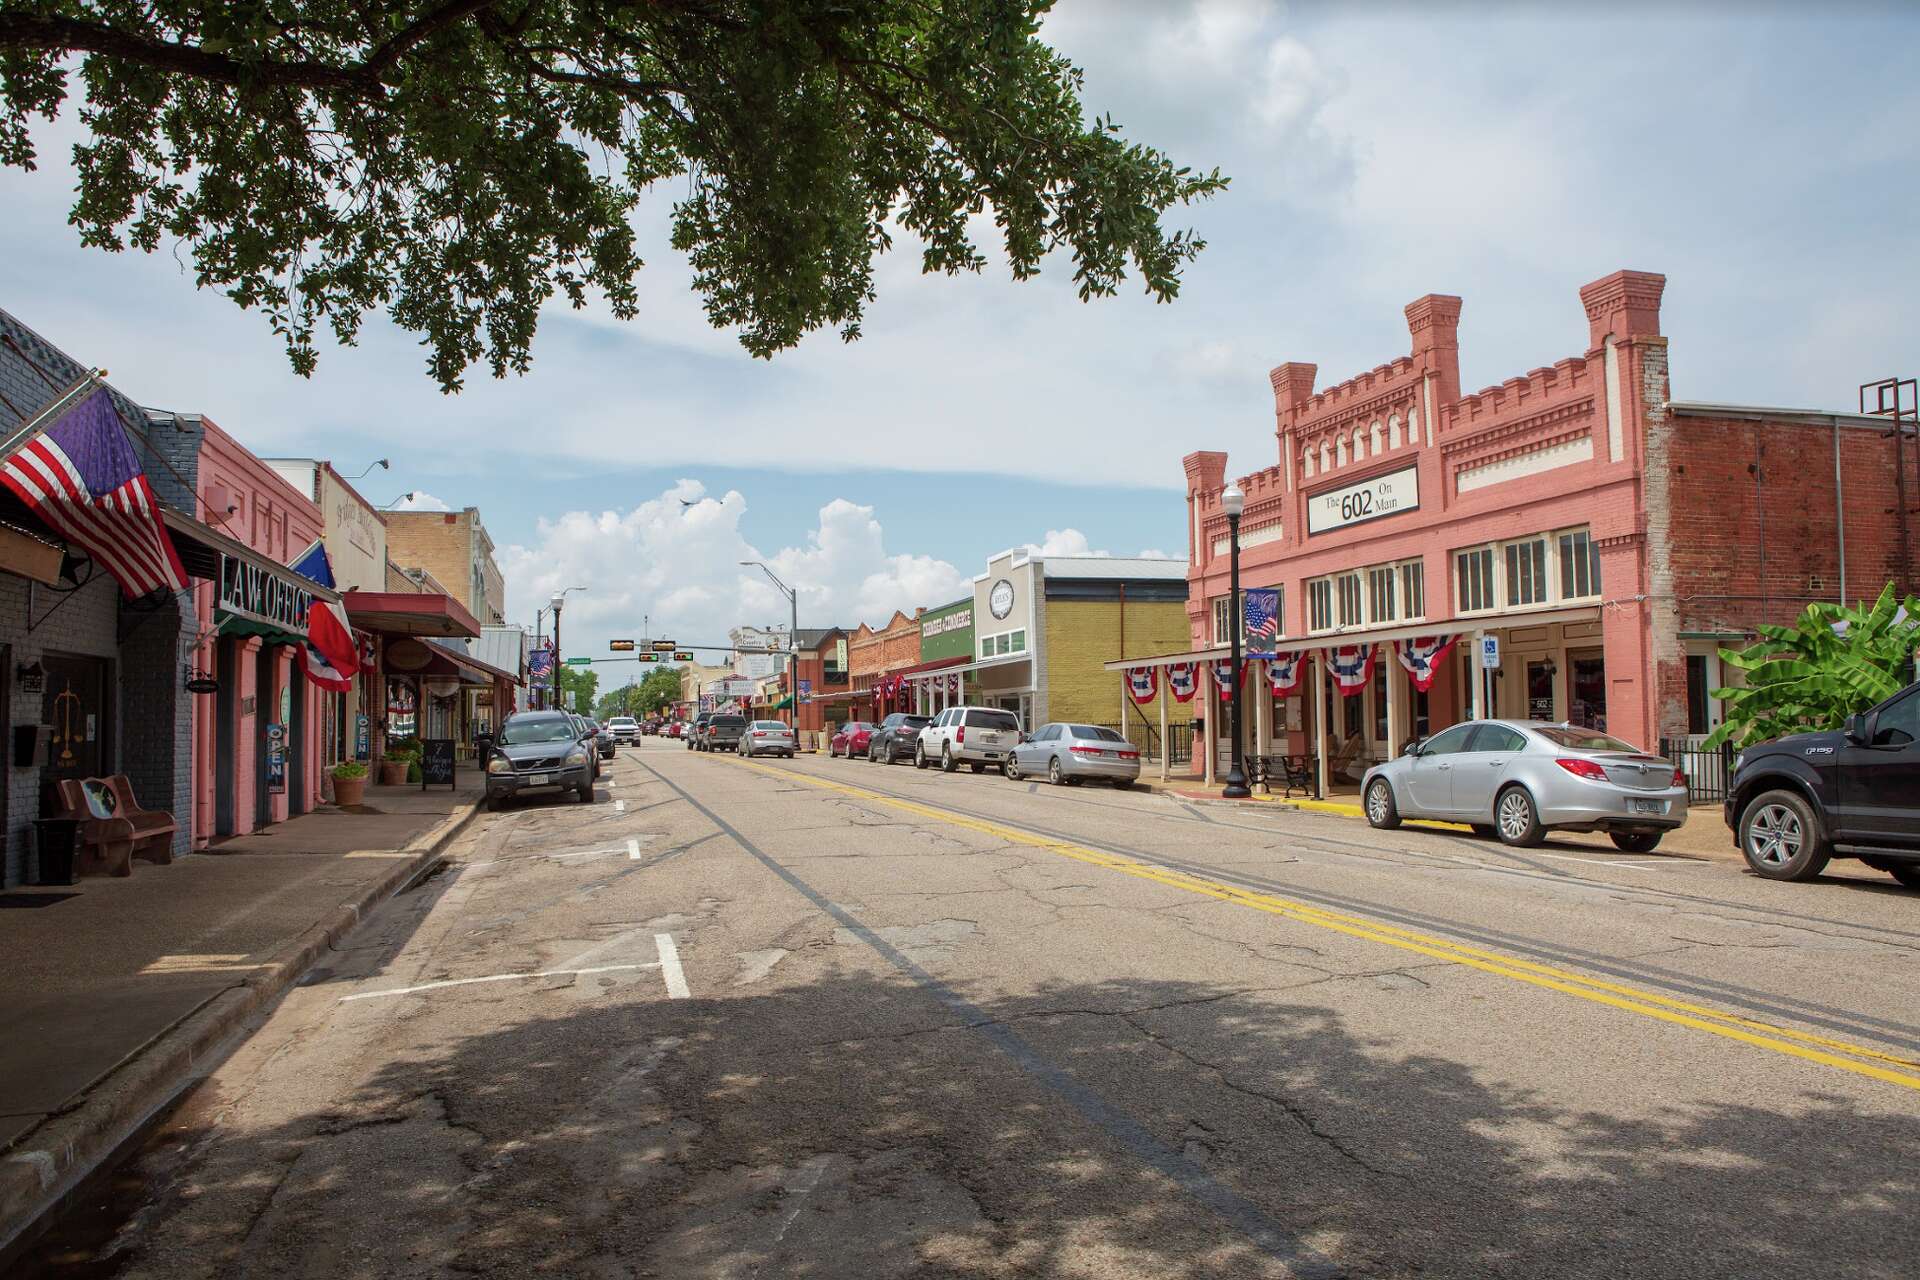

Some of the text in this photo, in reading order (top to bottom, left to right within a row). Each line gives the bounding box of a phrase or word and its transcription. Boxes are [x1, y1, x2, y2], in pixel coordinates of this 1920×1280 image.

[1326, 489, 1373, 520] The 602
[1378, 482, 1393, 496] On
[1375, 498, 1398, 512] Main
[220, 552, 312, 632] LAW OFFICE
[271, 728, 282, 776] OPEN
